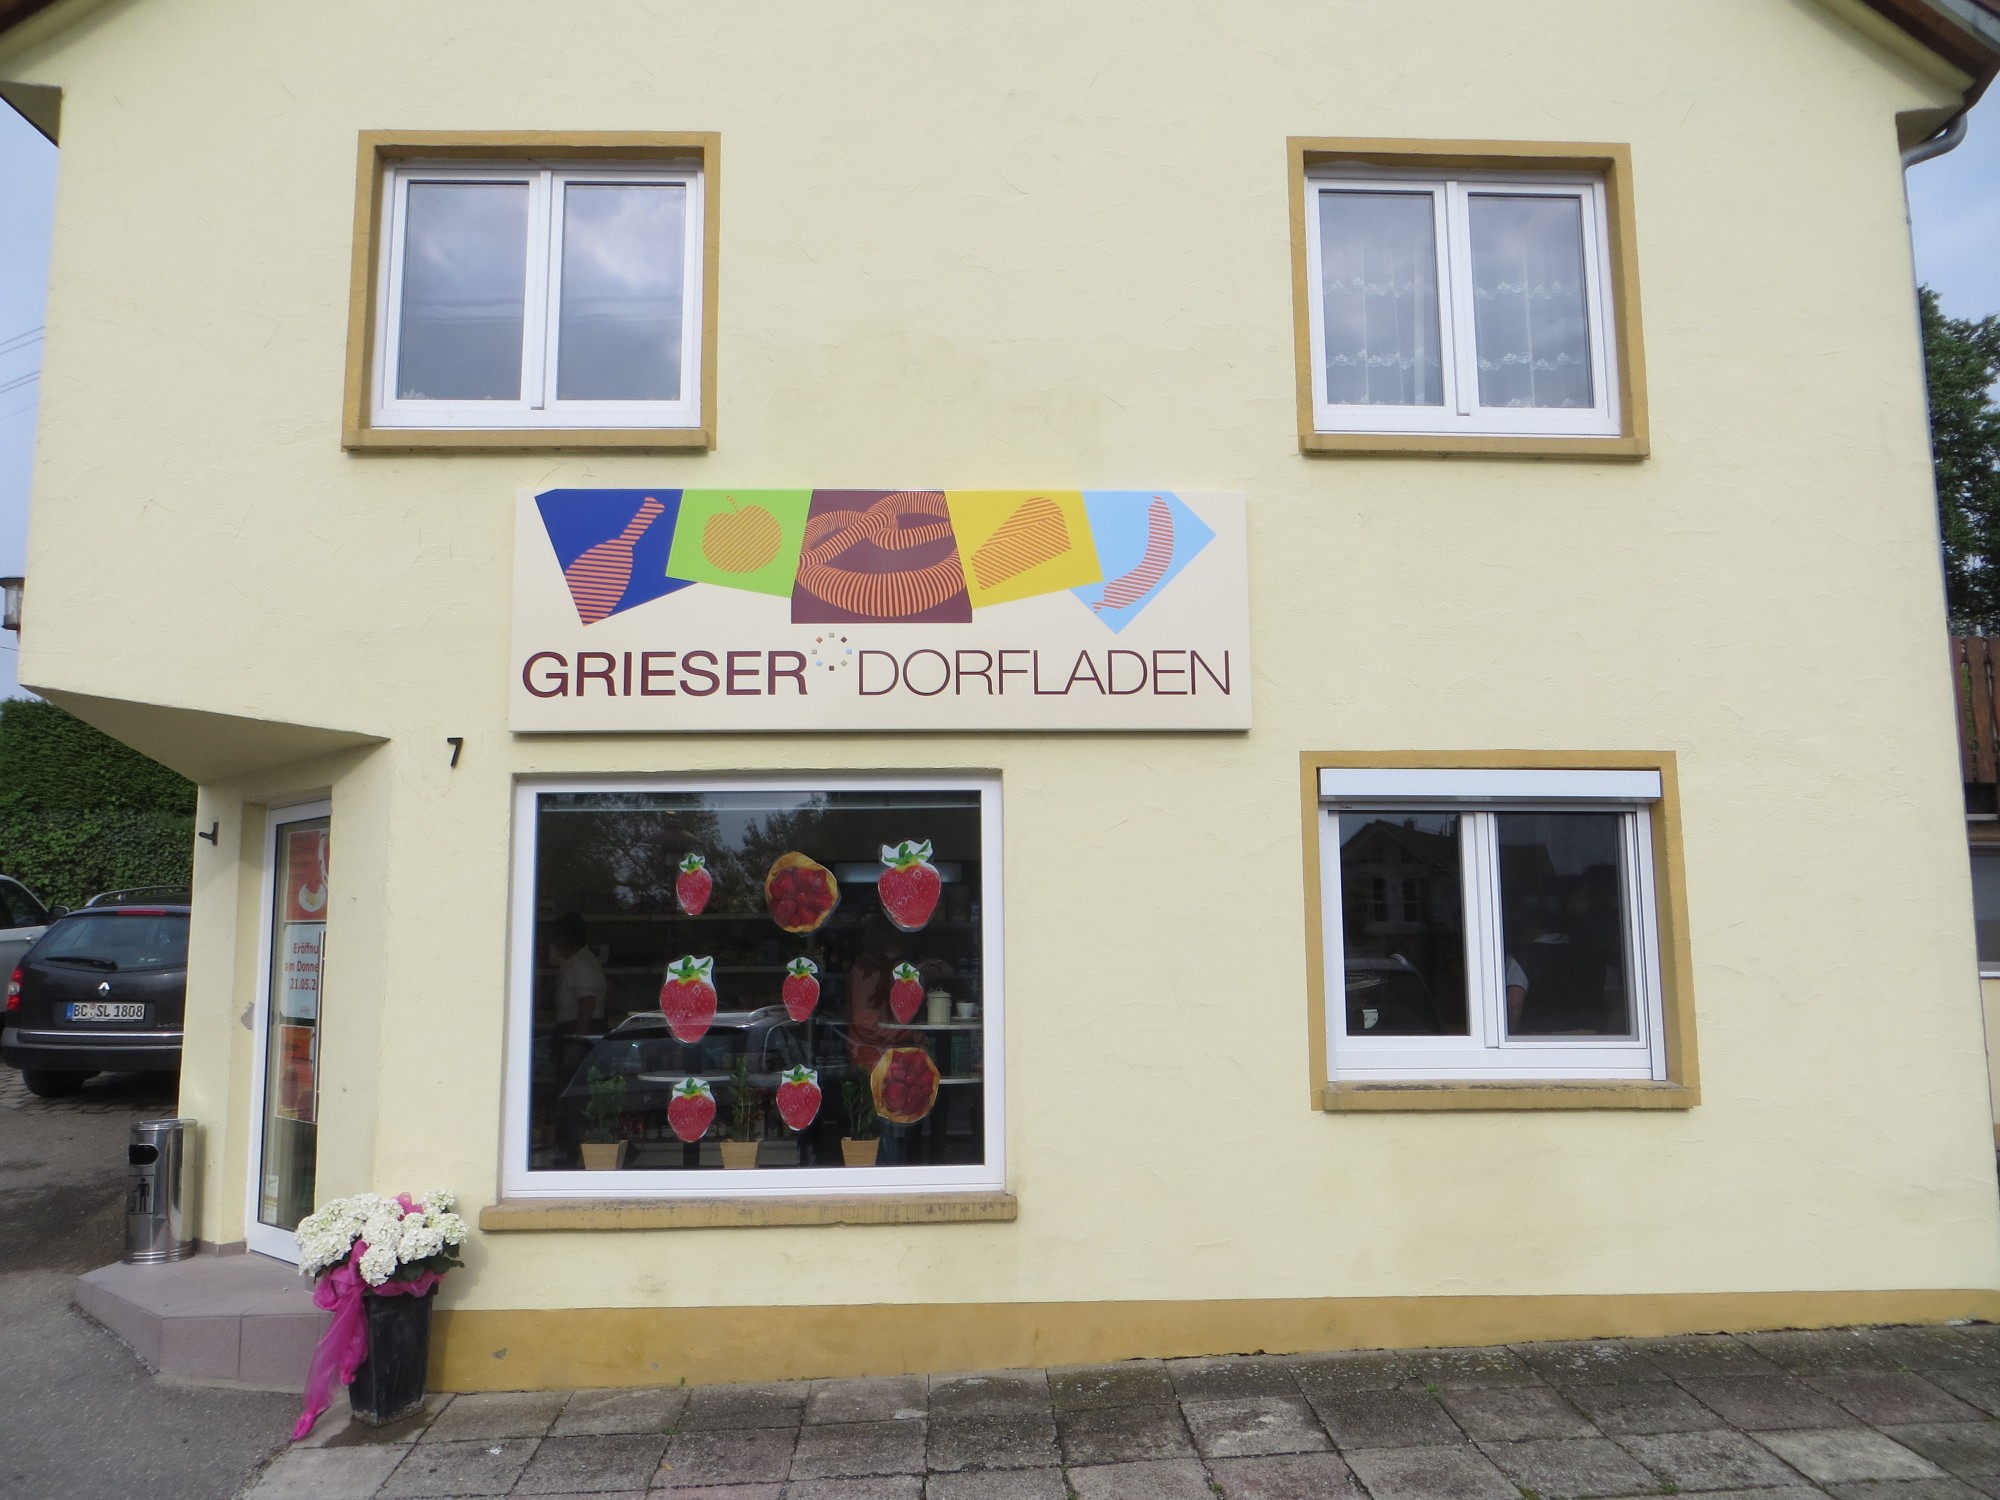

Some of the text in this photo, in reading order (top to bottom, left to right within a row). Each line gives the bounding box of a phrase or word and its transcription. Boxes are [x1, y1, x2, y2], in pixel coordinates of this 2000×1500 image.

[522, 648, 1231, 698] GRIESER DORFLADEN
[447, 737, 464, 769] 7
[285, 963, 295, 972] am
[73, 1004, 143, 1018] BC SL 1808
